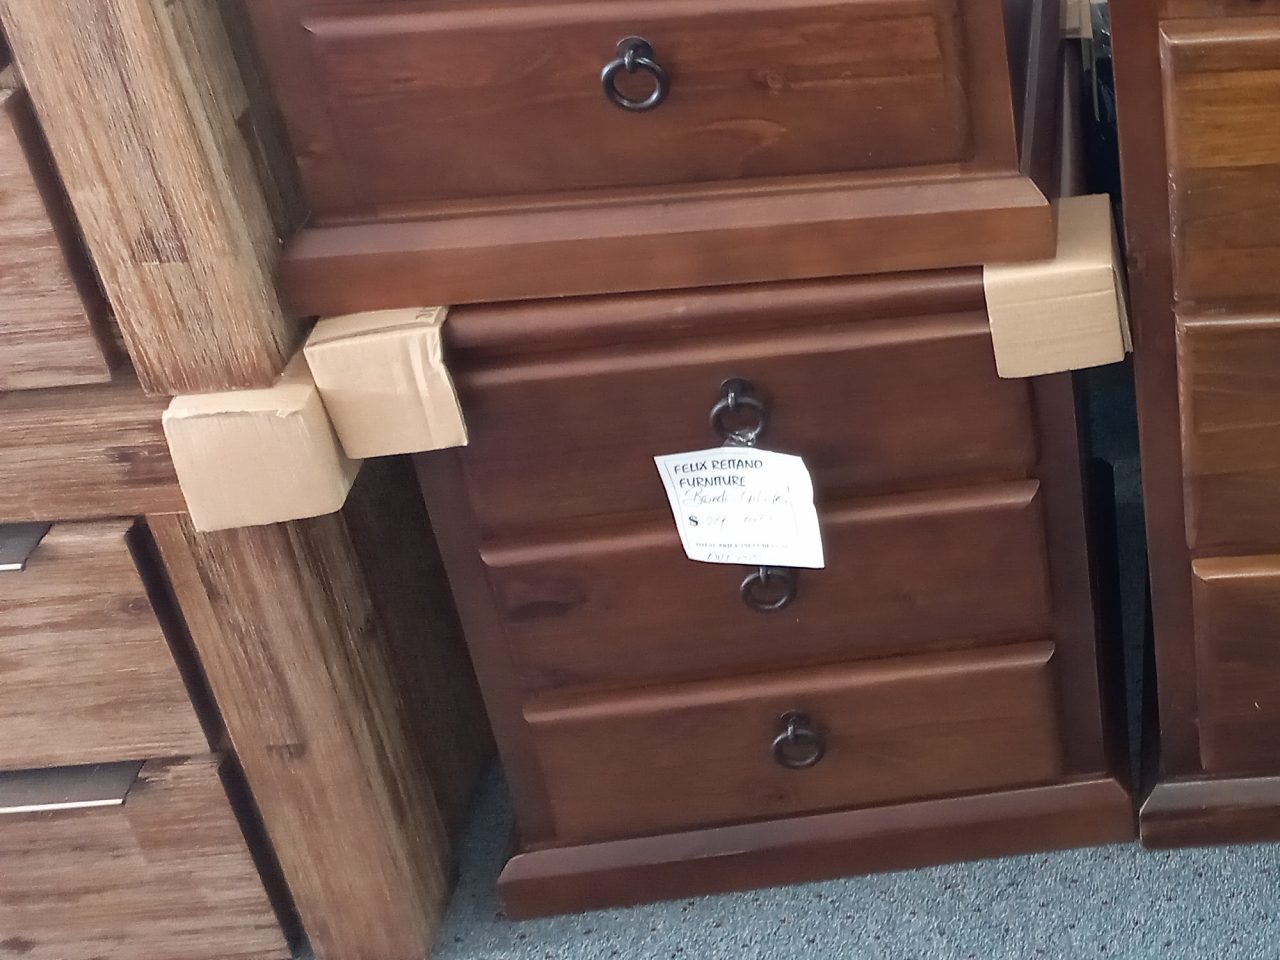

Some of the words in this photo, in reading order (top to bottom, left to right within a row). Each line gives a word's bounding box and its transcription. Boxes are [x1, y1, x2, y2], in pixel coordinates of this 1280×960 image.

[673, 459, 708, 475] FELIX
[711, 458, 763, 472] REITANO
[679, 475, 748, 489] FURNITURE
